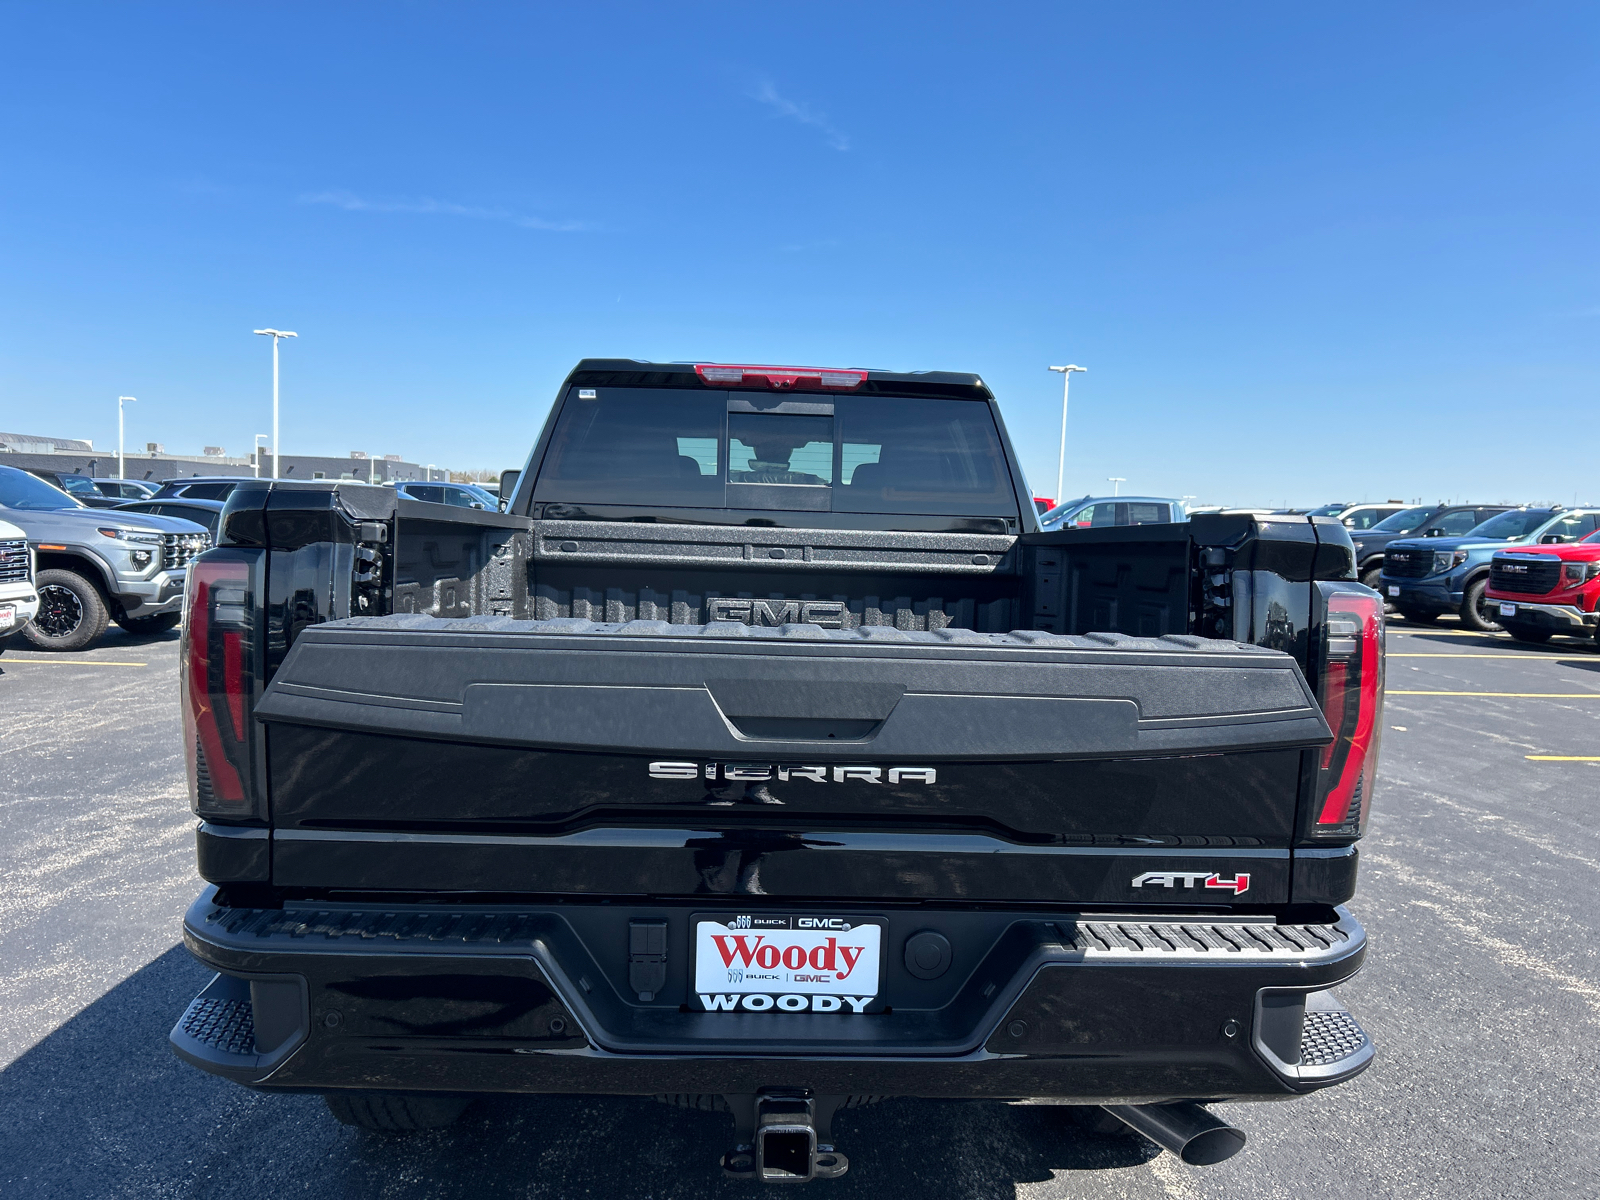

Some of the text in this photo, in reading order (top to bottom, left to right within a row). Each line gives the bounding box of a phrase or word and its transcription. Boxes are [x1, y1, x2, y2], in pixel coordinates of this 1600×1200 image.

[709, 600, 844, 629] GMC
[648, 761, 937, 785] SIERRA
[1131, 872, 1251, 896] AT4
[797, 917, 844, 928] GMC
[710, 934, 866, 980] Woody
[793, 973, 831, 983] GMC
[699, 993, 875, 1013] WOODY
